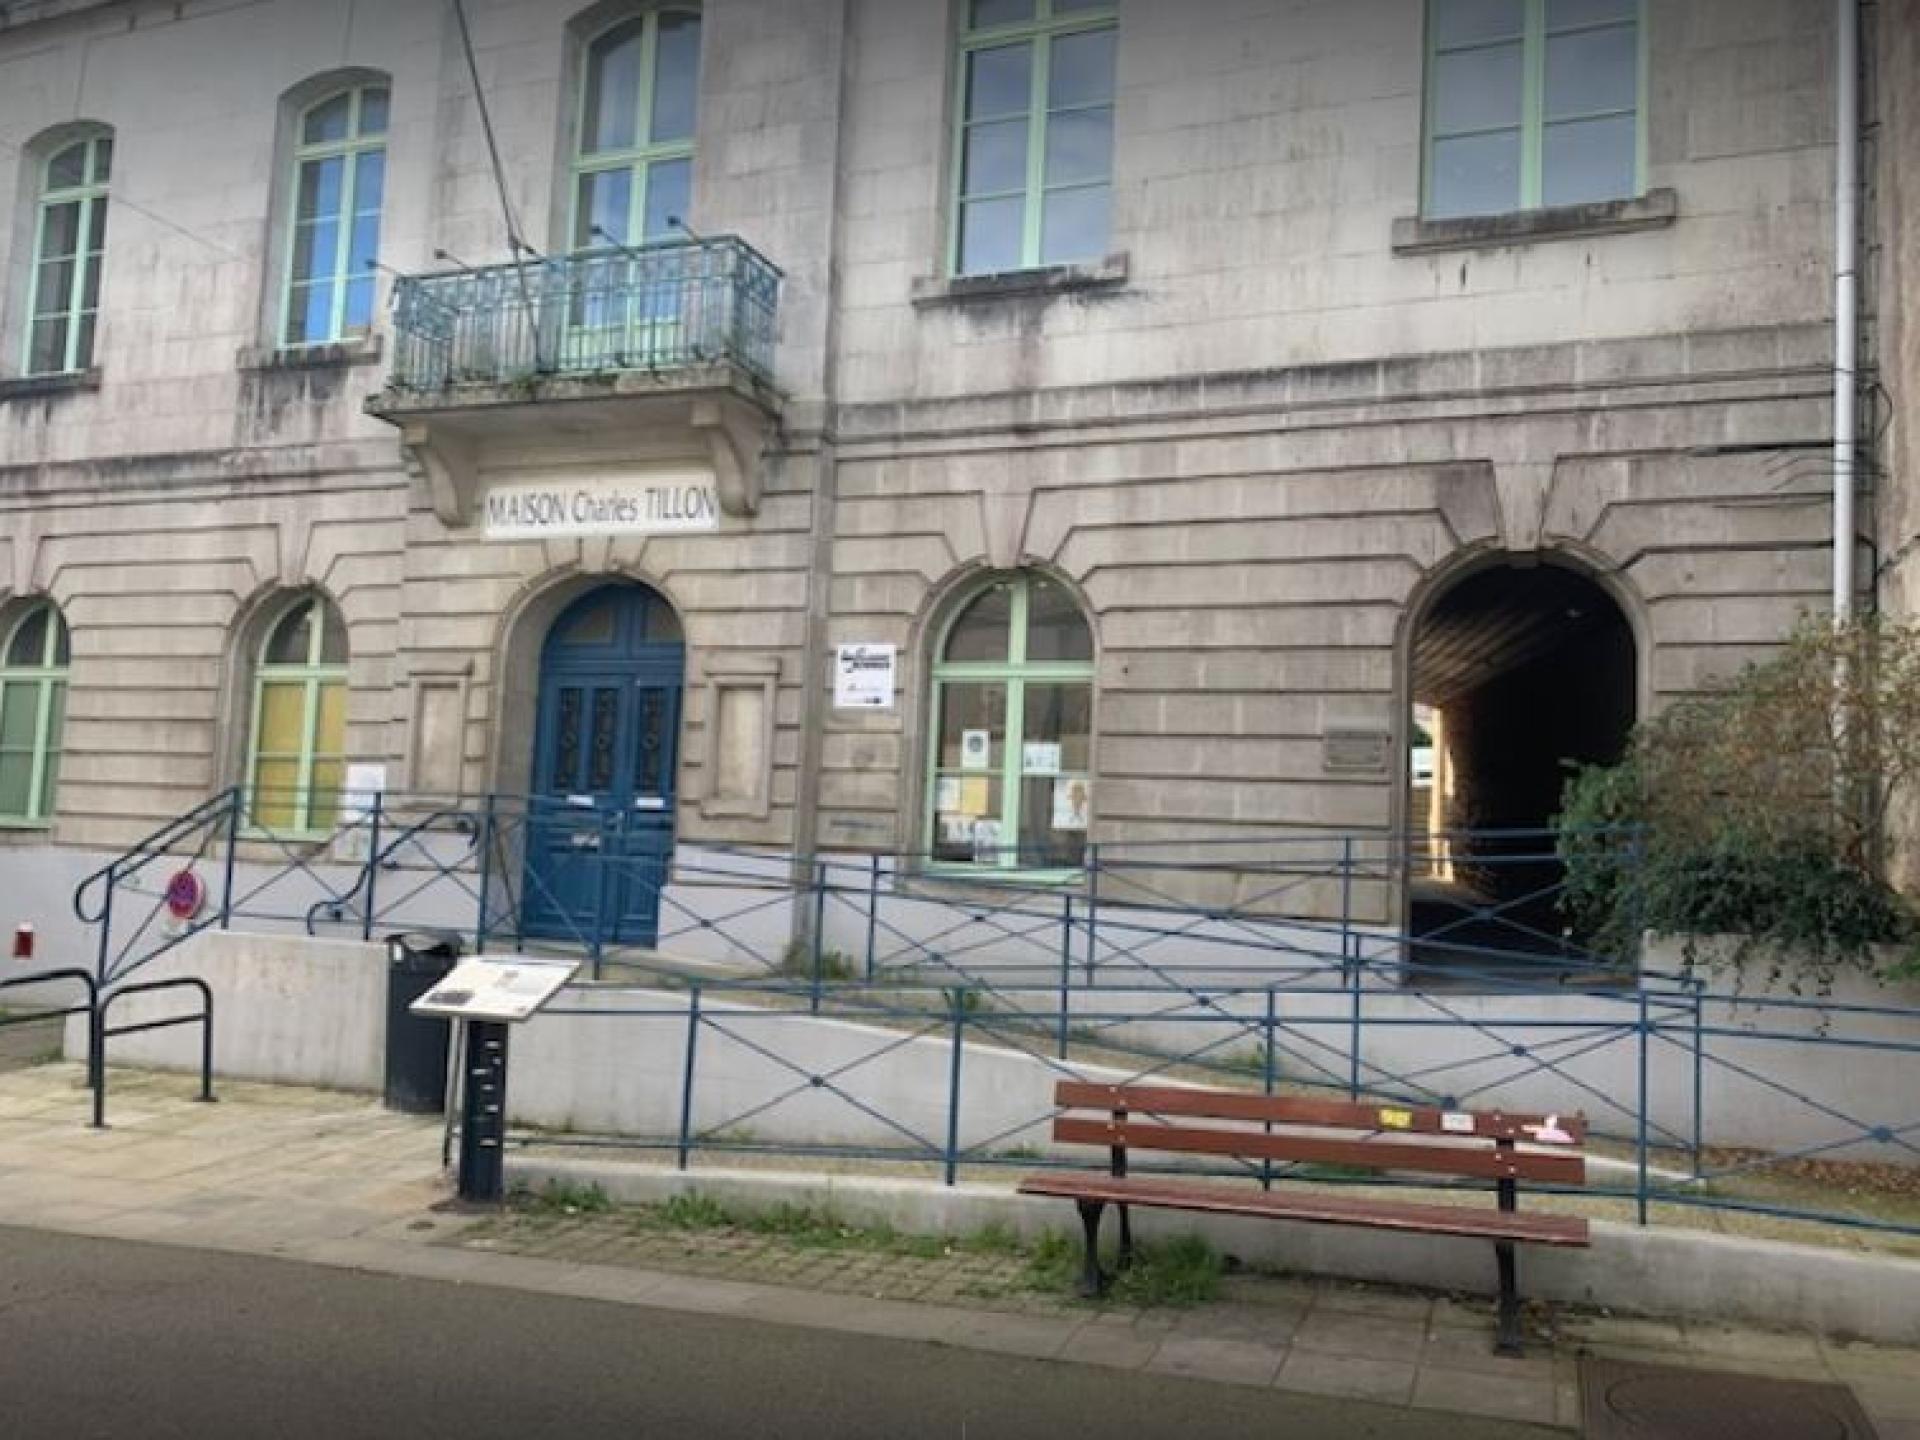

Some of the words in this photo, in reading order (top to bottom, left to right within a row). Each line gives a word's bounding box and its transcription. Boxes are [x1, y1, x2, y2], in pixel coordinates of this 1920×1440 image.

[488, 493, 565, 525] MAISON
[571, 489, 638, 523] Charles
[645, 486, 715, 520] TILLON
